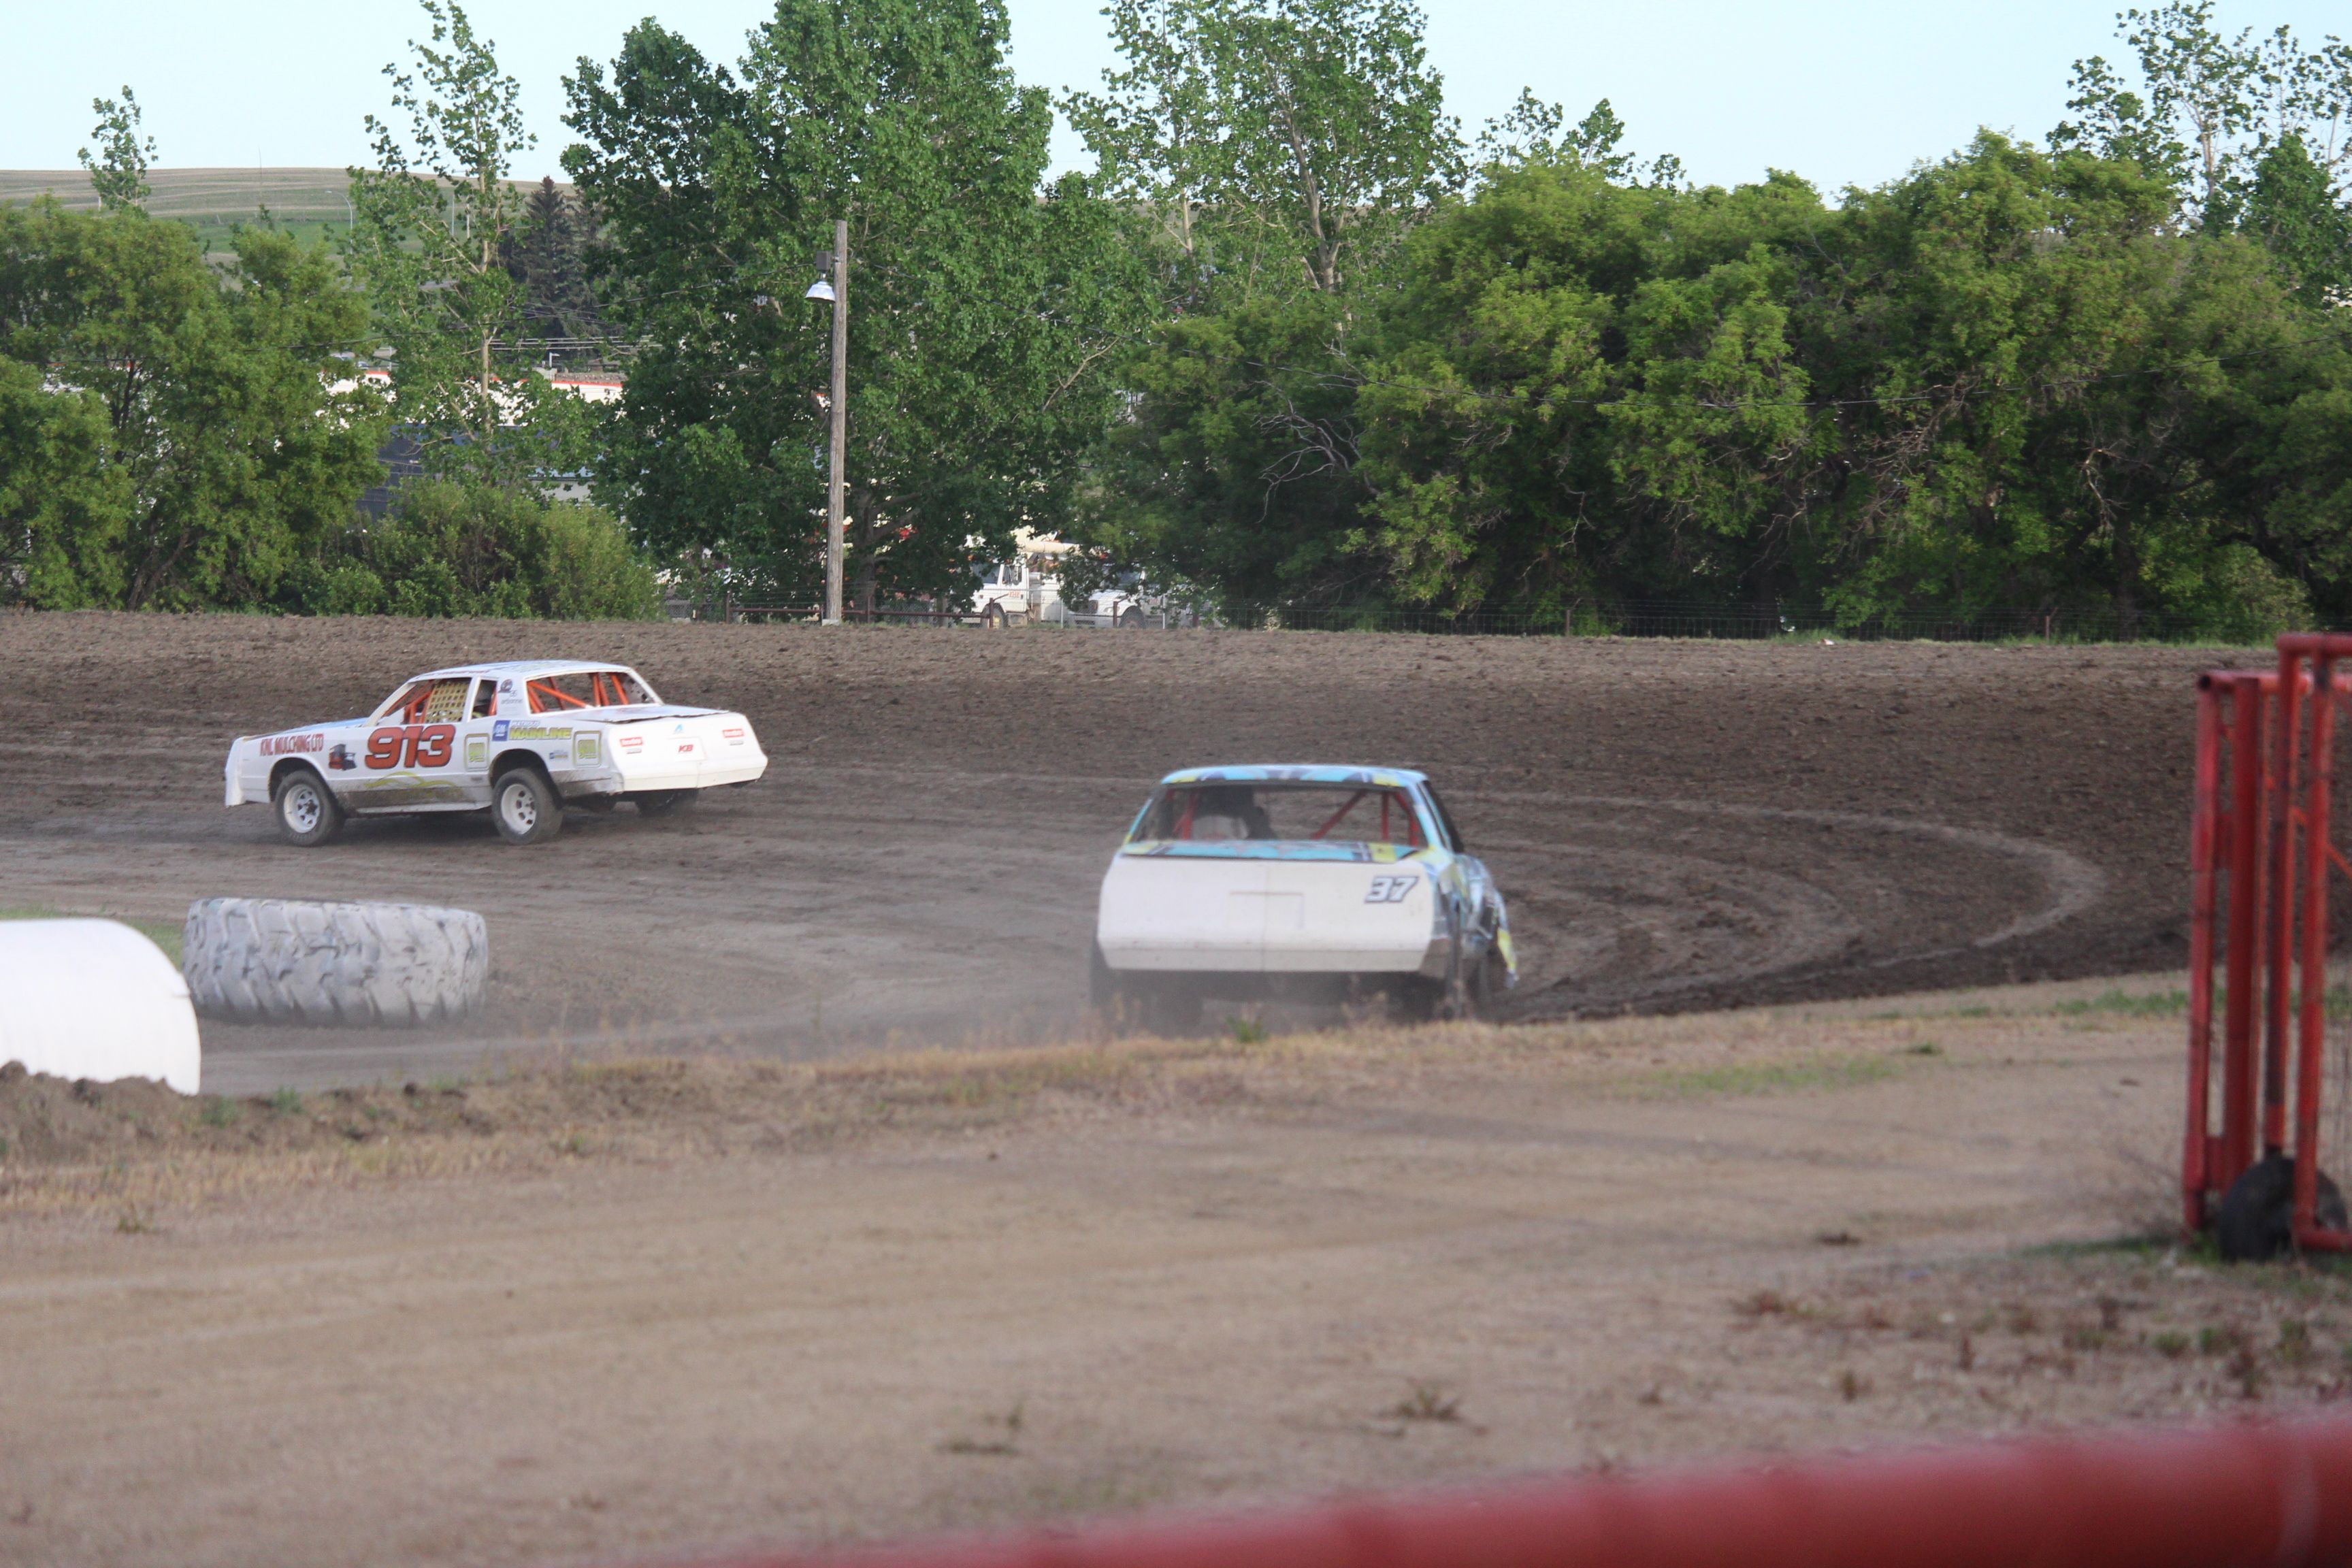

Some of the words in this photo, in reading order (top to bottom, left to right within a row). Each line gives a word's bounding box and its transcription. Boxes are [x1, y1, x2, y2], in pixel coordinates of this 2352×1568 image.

[510, 727, 573, 740] MAINLINE
[365, 724, 456, 770] 913
[678, 745, 694, 753] KB
[1364, 875, 1420, 903] 37
